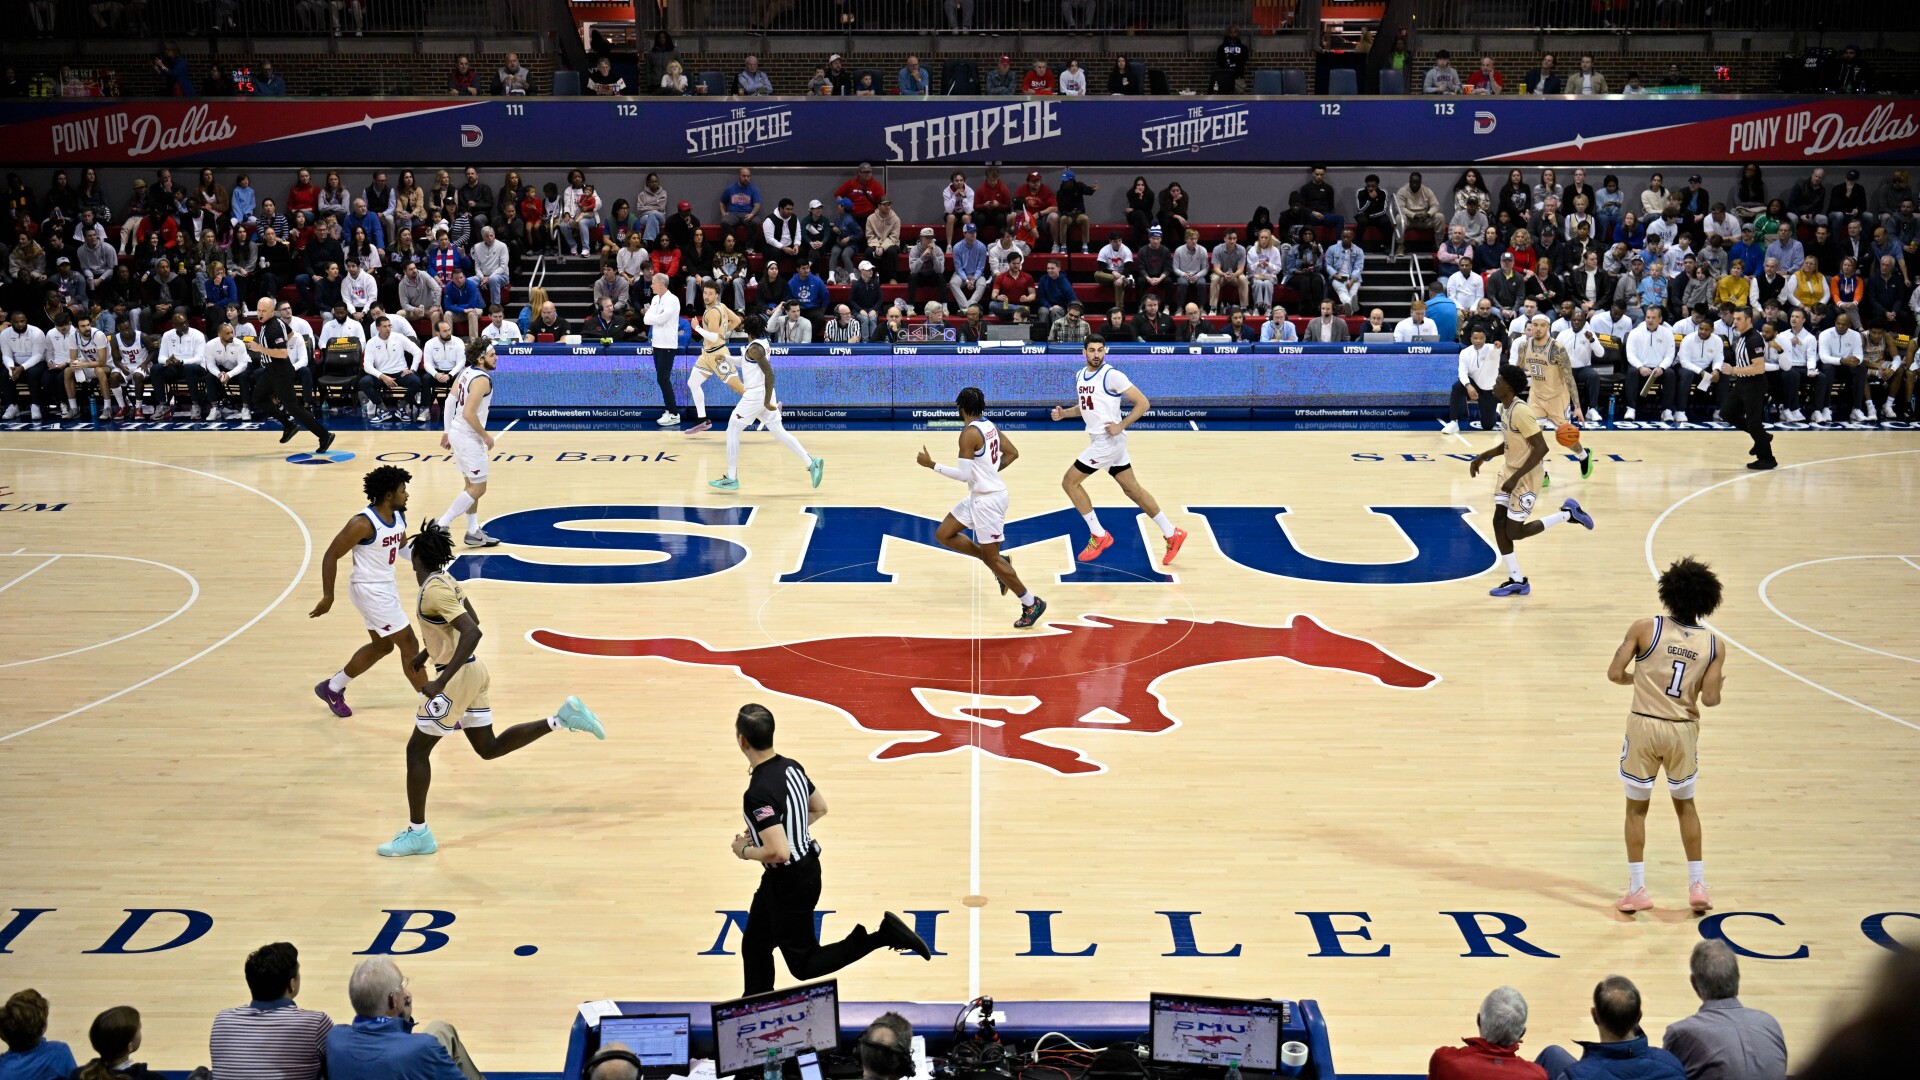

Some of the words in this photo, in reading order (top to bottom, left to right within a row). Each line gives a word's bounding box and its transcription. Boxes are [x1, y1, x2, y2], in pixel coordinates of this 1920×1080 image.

[506, 104, 524, 116] 111
[617, 104, 638, 116] 112
[731, 107, 746, 119] THE
[1187, 106, 1204, 118] THE
[1320, 103, 1341, 116] 112
[1434, 103, 1455, 115] 113
[51, 116, 99, 156] PONY
[104, 112, 129, 146] UP
[127, 103, 237, 157] Dallas
[686, 111, 793, 155] STAMPEDE
[884, 101, 1062, 162] STAMPEDE
[1141, 109, 1249, 154] STAMPEDE
[1729, 115, 1782, 154] PONY
[1785, 110, 1811, 144] UP
[1803, 102, 1919, 156] Dallas
[508, 347, 533, 355] UTSW
[572, 347, 597, 355] UTSW
[636, 347, 654, 355] UTS
[769, 347, 790, 355] TSW
[893, 347, 918, 355] UTSW
[957, 347, 981, 355] UTSW
[1021, 347, 1046, 355] UTSW
[1150, 347, 1175, 355] UTSW
[1214, 347, 1239, 355] UTSW
[1278, 347, 1303, 355] UTSW
[1343, 347, 1368, 355] UTSW
[1407, 347, 1432, 355] UTSW
[129, 354, 136, 364] 2
[1530, 364, 1543, 376] 31
[1078, 386, 1095, 394] SMU
[1080, 395, 1095, 410] 24
[375, 451, 534, 463] Oriin
[555, 451, 681, 463] Bank
[989, 438, 999, 465] 22
[1350, 452, 1644, 463] SEWLL
[382, 532, 404, 548] SMU
[451, 504, 1500, 584] SMU
[388, 547, 397, 565] 8
[1667, 645, 1699, 661] GEORGE
[1665, 659, 1687, 699] 1
[739, 1011, 806, 1035] SMU
[1176, 1020, 1246, 1034] SMU
